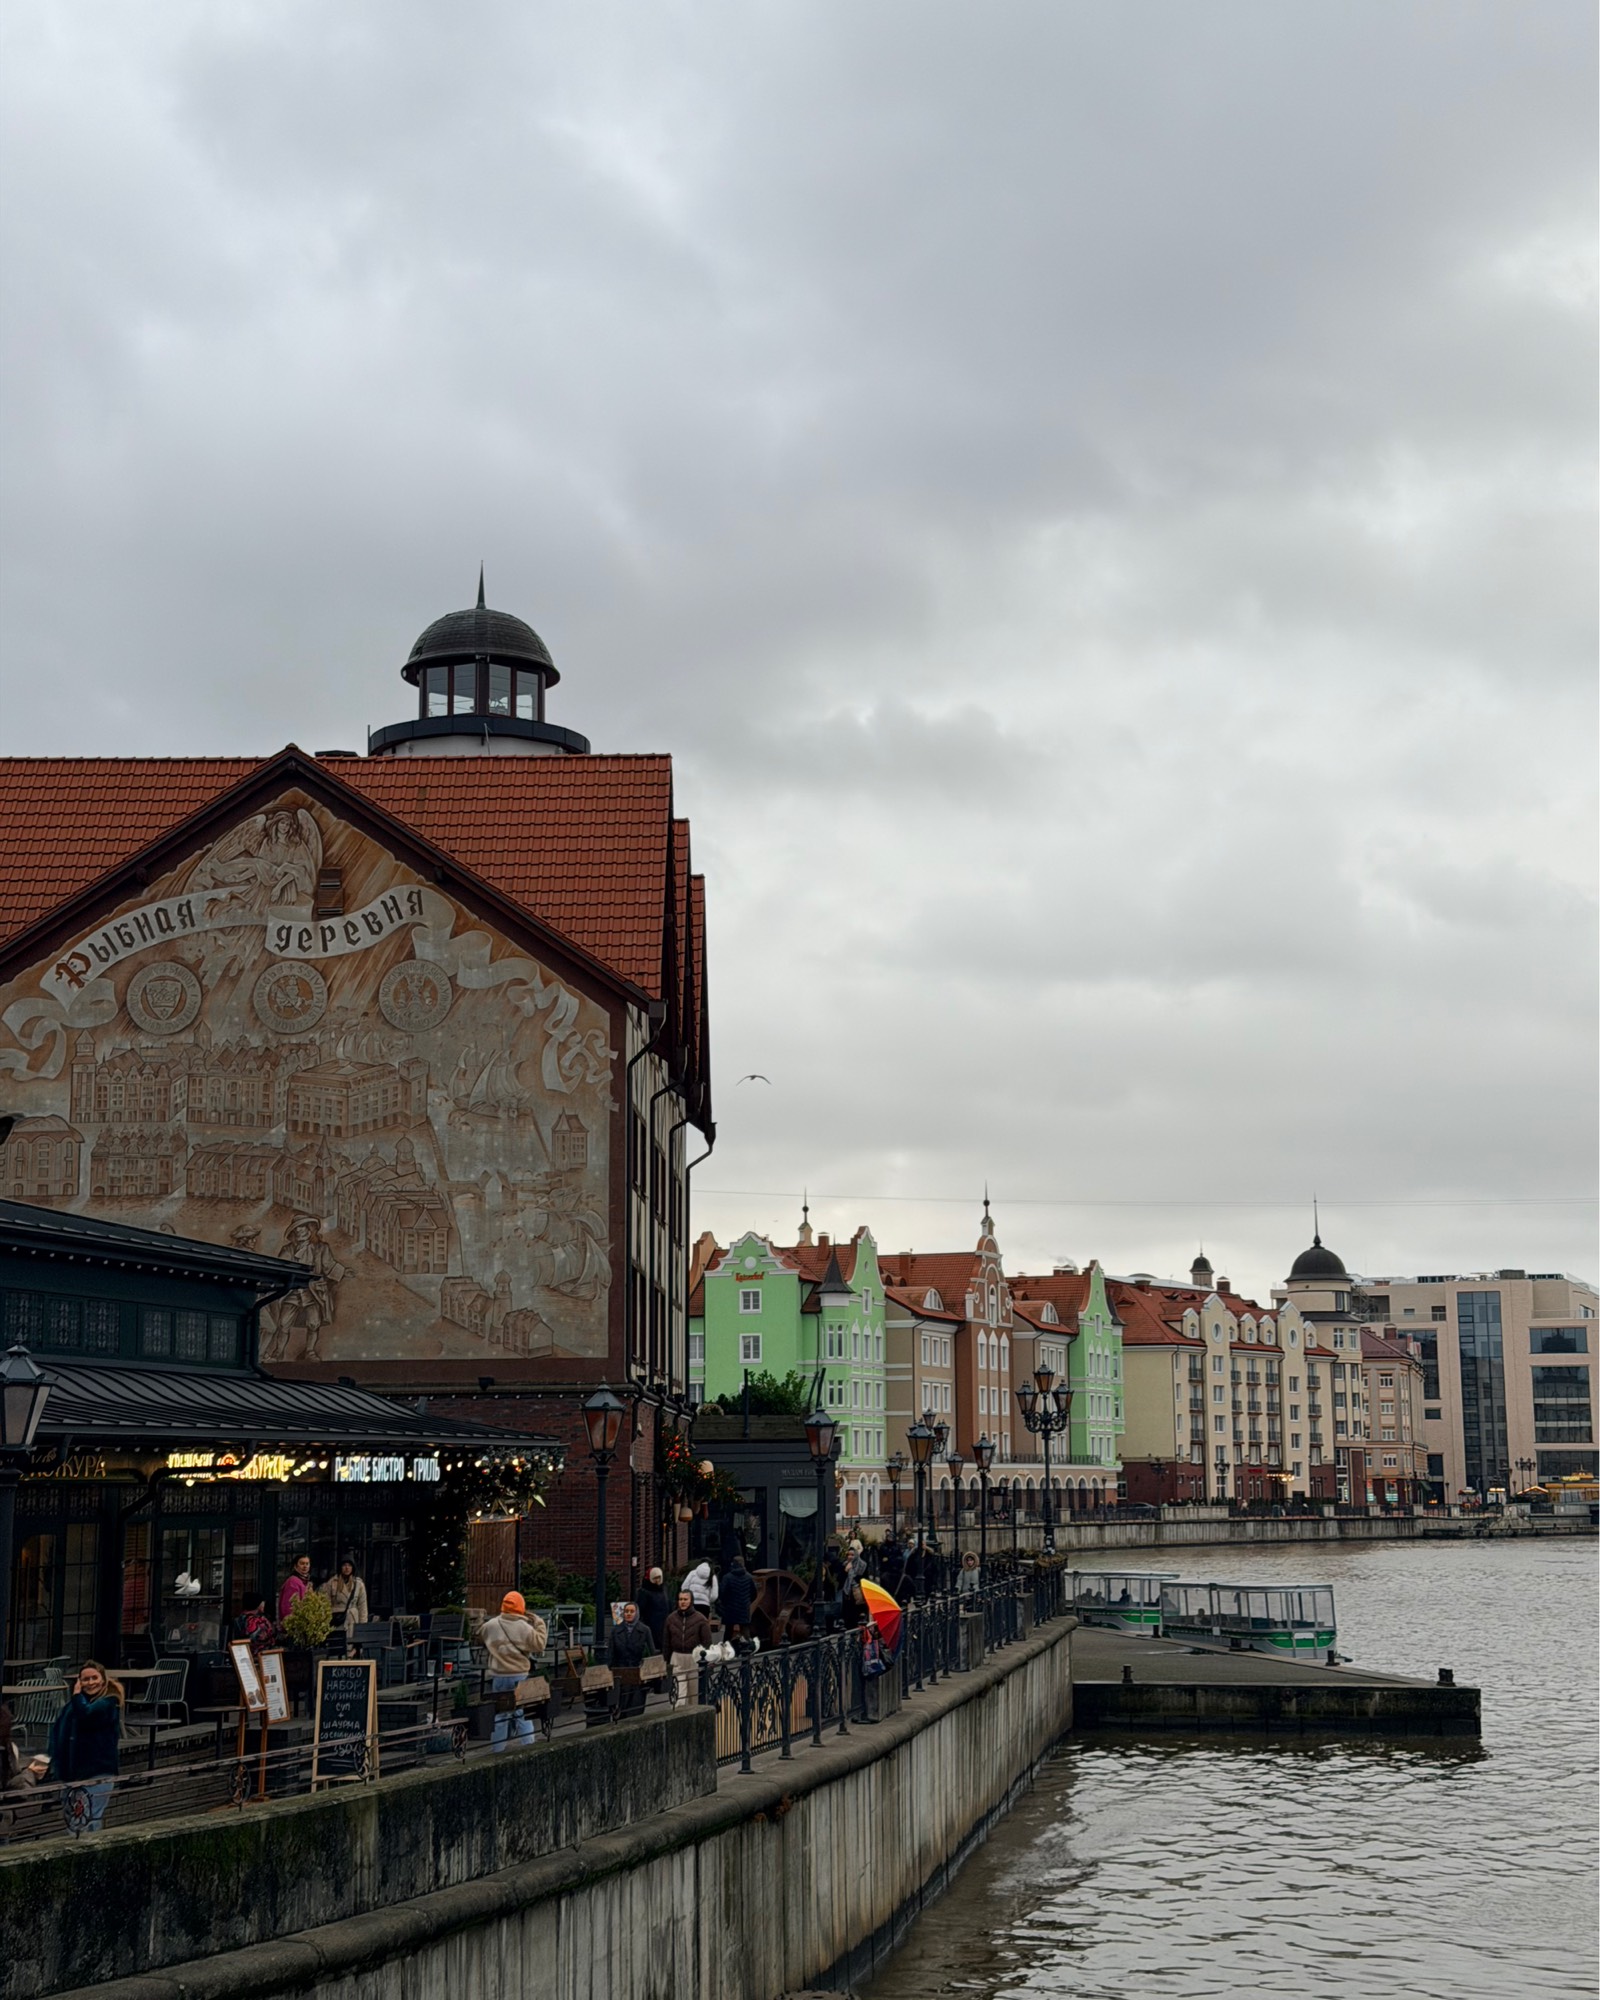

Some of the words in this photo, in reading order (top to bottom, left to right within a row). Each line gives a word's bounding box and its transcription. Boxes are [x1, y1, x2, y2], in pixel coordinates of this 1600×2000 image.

[275, 888, 424, 954] деревня
[334, 1456, 371, 1482] РЫБНОЕ
[372, 1457, 405, 1482] БИСТРО
[413, 1457, 440, 1482] ГРИЛЬ
[331, 1667, 362, 1679] КОМБО
[322, 1719, 361, 1730] ШАУРМА
